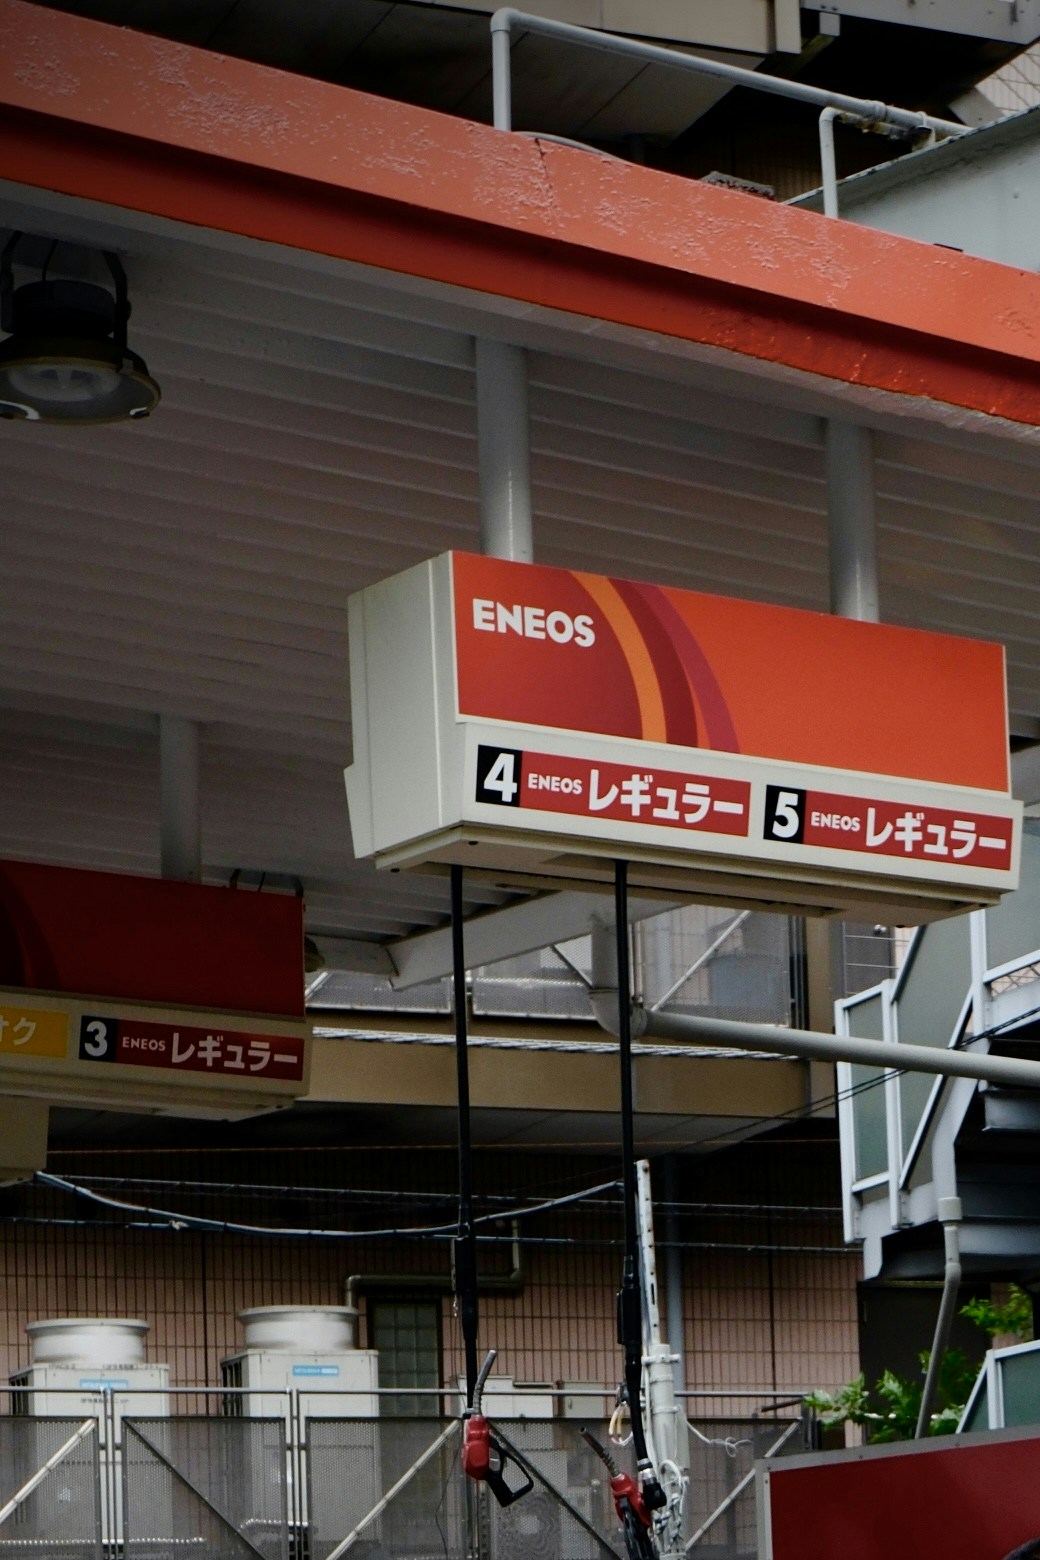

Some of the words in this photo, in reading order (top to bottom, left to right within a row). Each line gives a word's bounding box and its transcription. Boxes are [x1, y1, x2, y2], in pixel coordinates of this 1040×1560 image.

[472, 597, 595, 647] ENEOS
[483, 753, 518, 802] 4
[527, 772, 583, 796] ENEOS
[589, 769, 744, 823] レギュラー
[773, 793, 799, 838] 5
[811, 811, 861, 833] ENEOS
[866, 807, 1007, 859] レギュラー
[84, 1021, 108, 1057] 3
[122, 1036, 166, 1052] ENEOS
[171, 1032, 298, 1071] レギュラー
